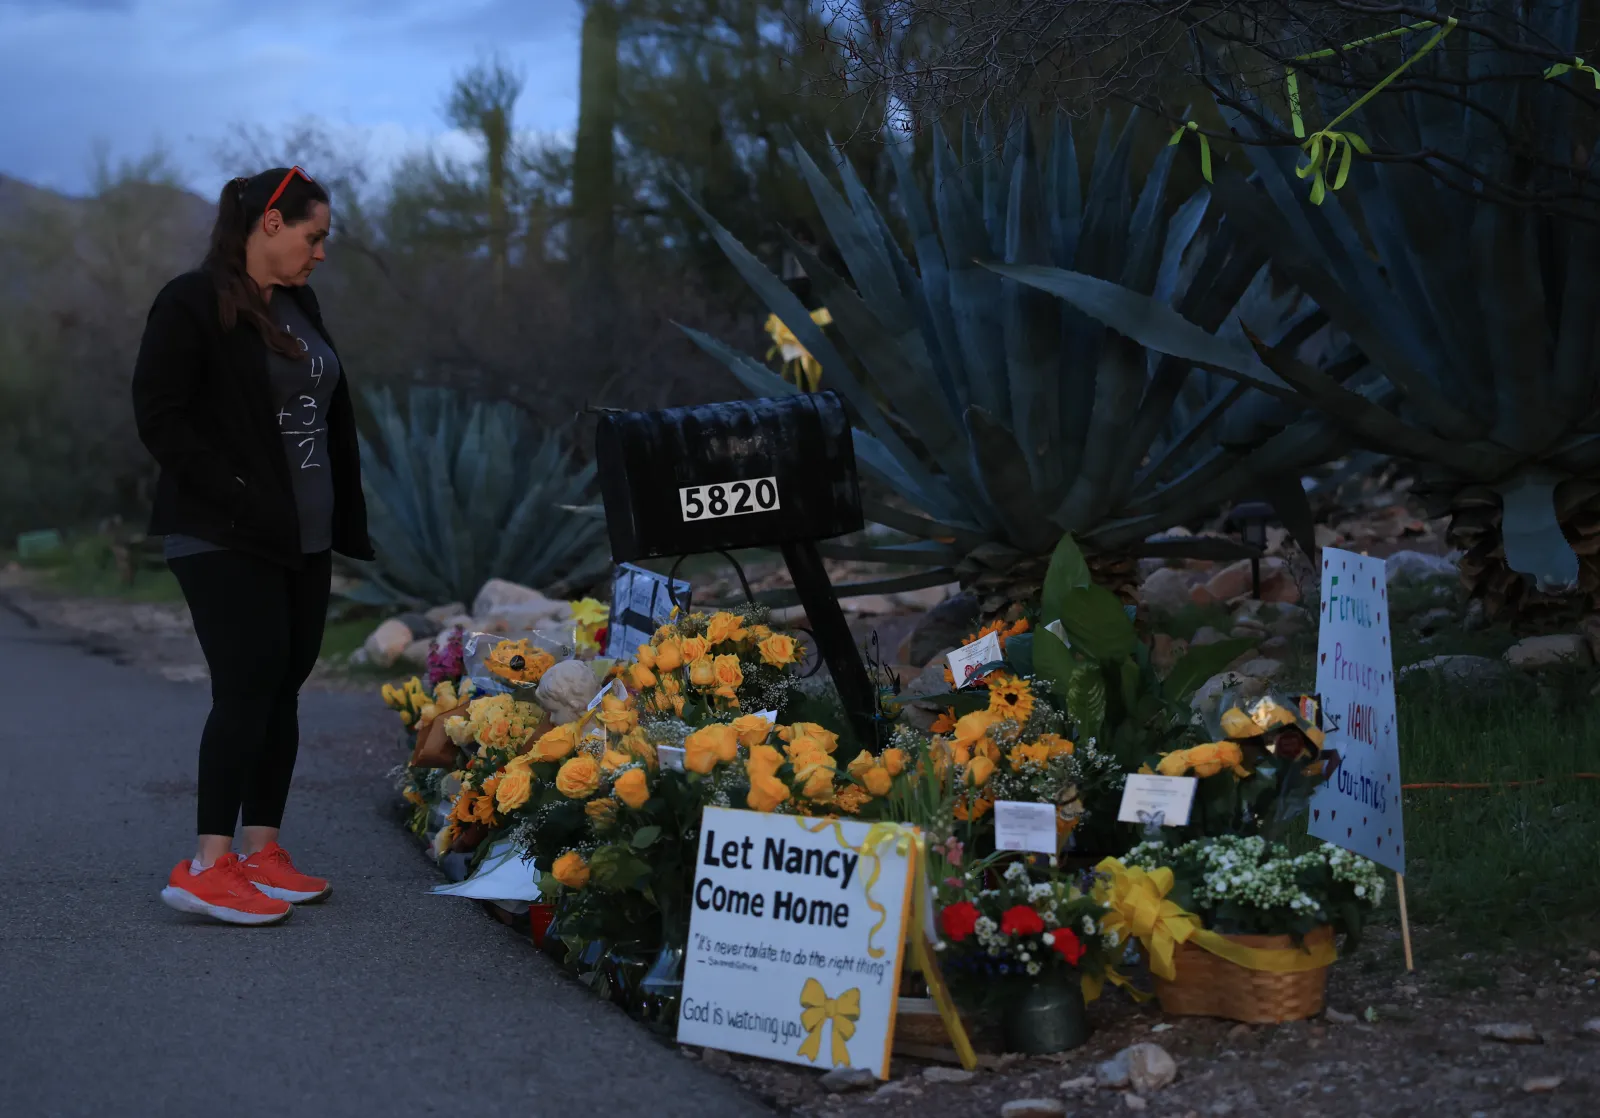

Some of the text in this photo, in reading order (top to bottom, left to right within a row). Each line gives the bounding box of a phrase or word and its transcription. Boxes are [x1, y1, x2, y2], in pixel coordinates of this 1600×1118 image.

[311, 356, 323, 388] 4
[299, 395, 318, 425] 3
[298, 437, 320, 469] 2
[686, 479, 776, 519] 5820
[703, 830, 859, 889] Let Nancy
[695, 877, 849, 928] Come Home
[714, 941, 743, 955] never
[757, 941, 777, 961] late
[780, 947, 791, 962] to
[793, 948, 807, 965] do
[809, 950, 826, 968] the
[827, 954, 855, 976] right
[683, 997, 801, 1045] God is watching you
